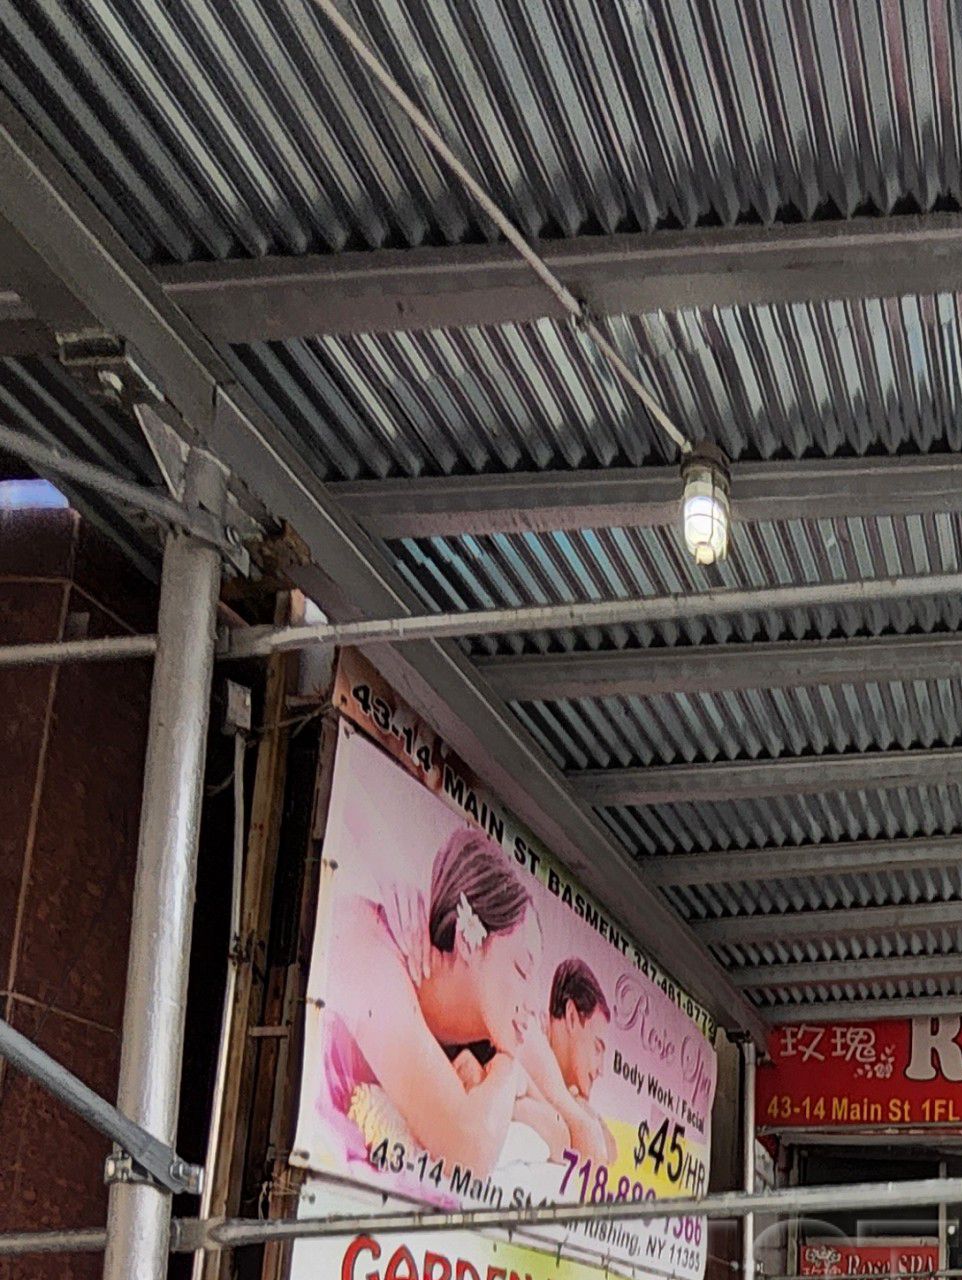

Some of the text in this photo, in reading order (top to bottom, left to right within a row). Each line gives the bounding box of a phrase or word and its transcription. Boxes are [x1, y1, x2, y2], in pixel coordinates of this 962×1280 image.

[353, 685, 431, 772] 43-14
[445, 767, 505, 845] MAIN
[514, 837, 541, 876] ST
[548, 873, 630, 957] BASMENT
[779, 1025, 876, 1063] 玫瑰
[613, 1049, 643, 1095] Body
[648, 1073, 674, 1109] Work
[682, 1100, 705, 1135] Facial
[767, 1097, 960, 1122] 43-14 Main St 1FL
[371, 1136, 444, 1187] 43-14
[450, 1166, 503, 1212] Main
[646, 1234, 667, 1260] NY
